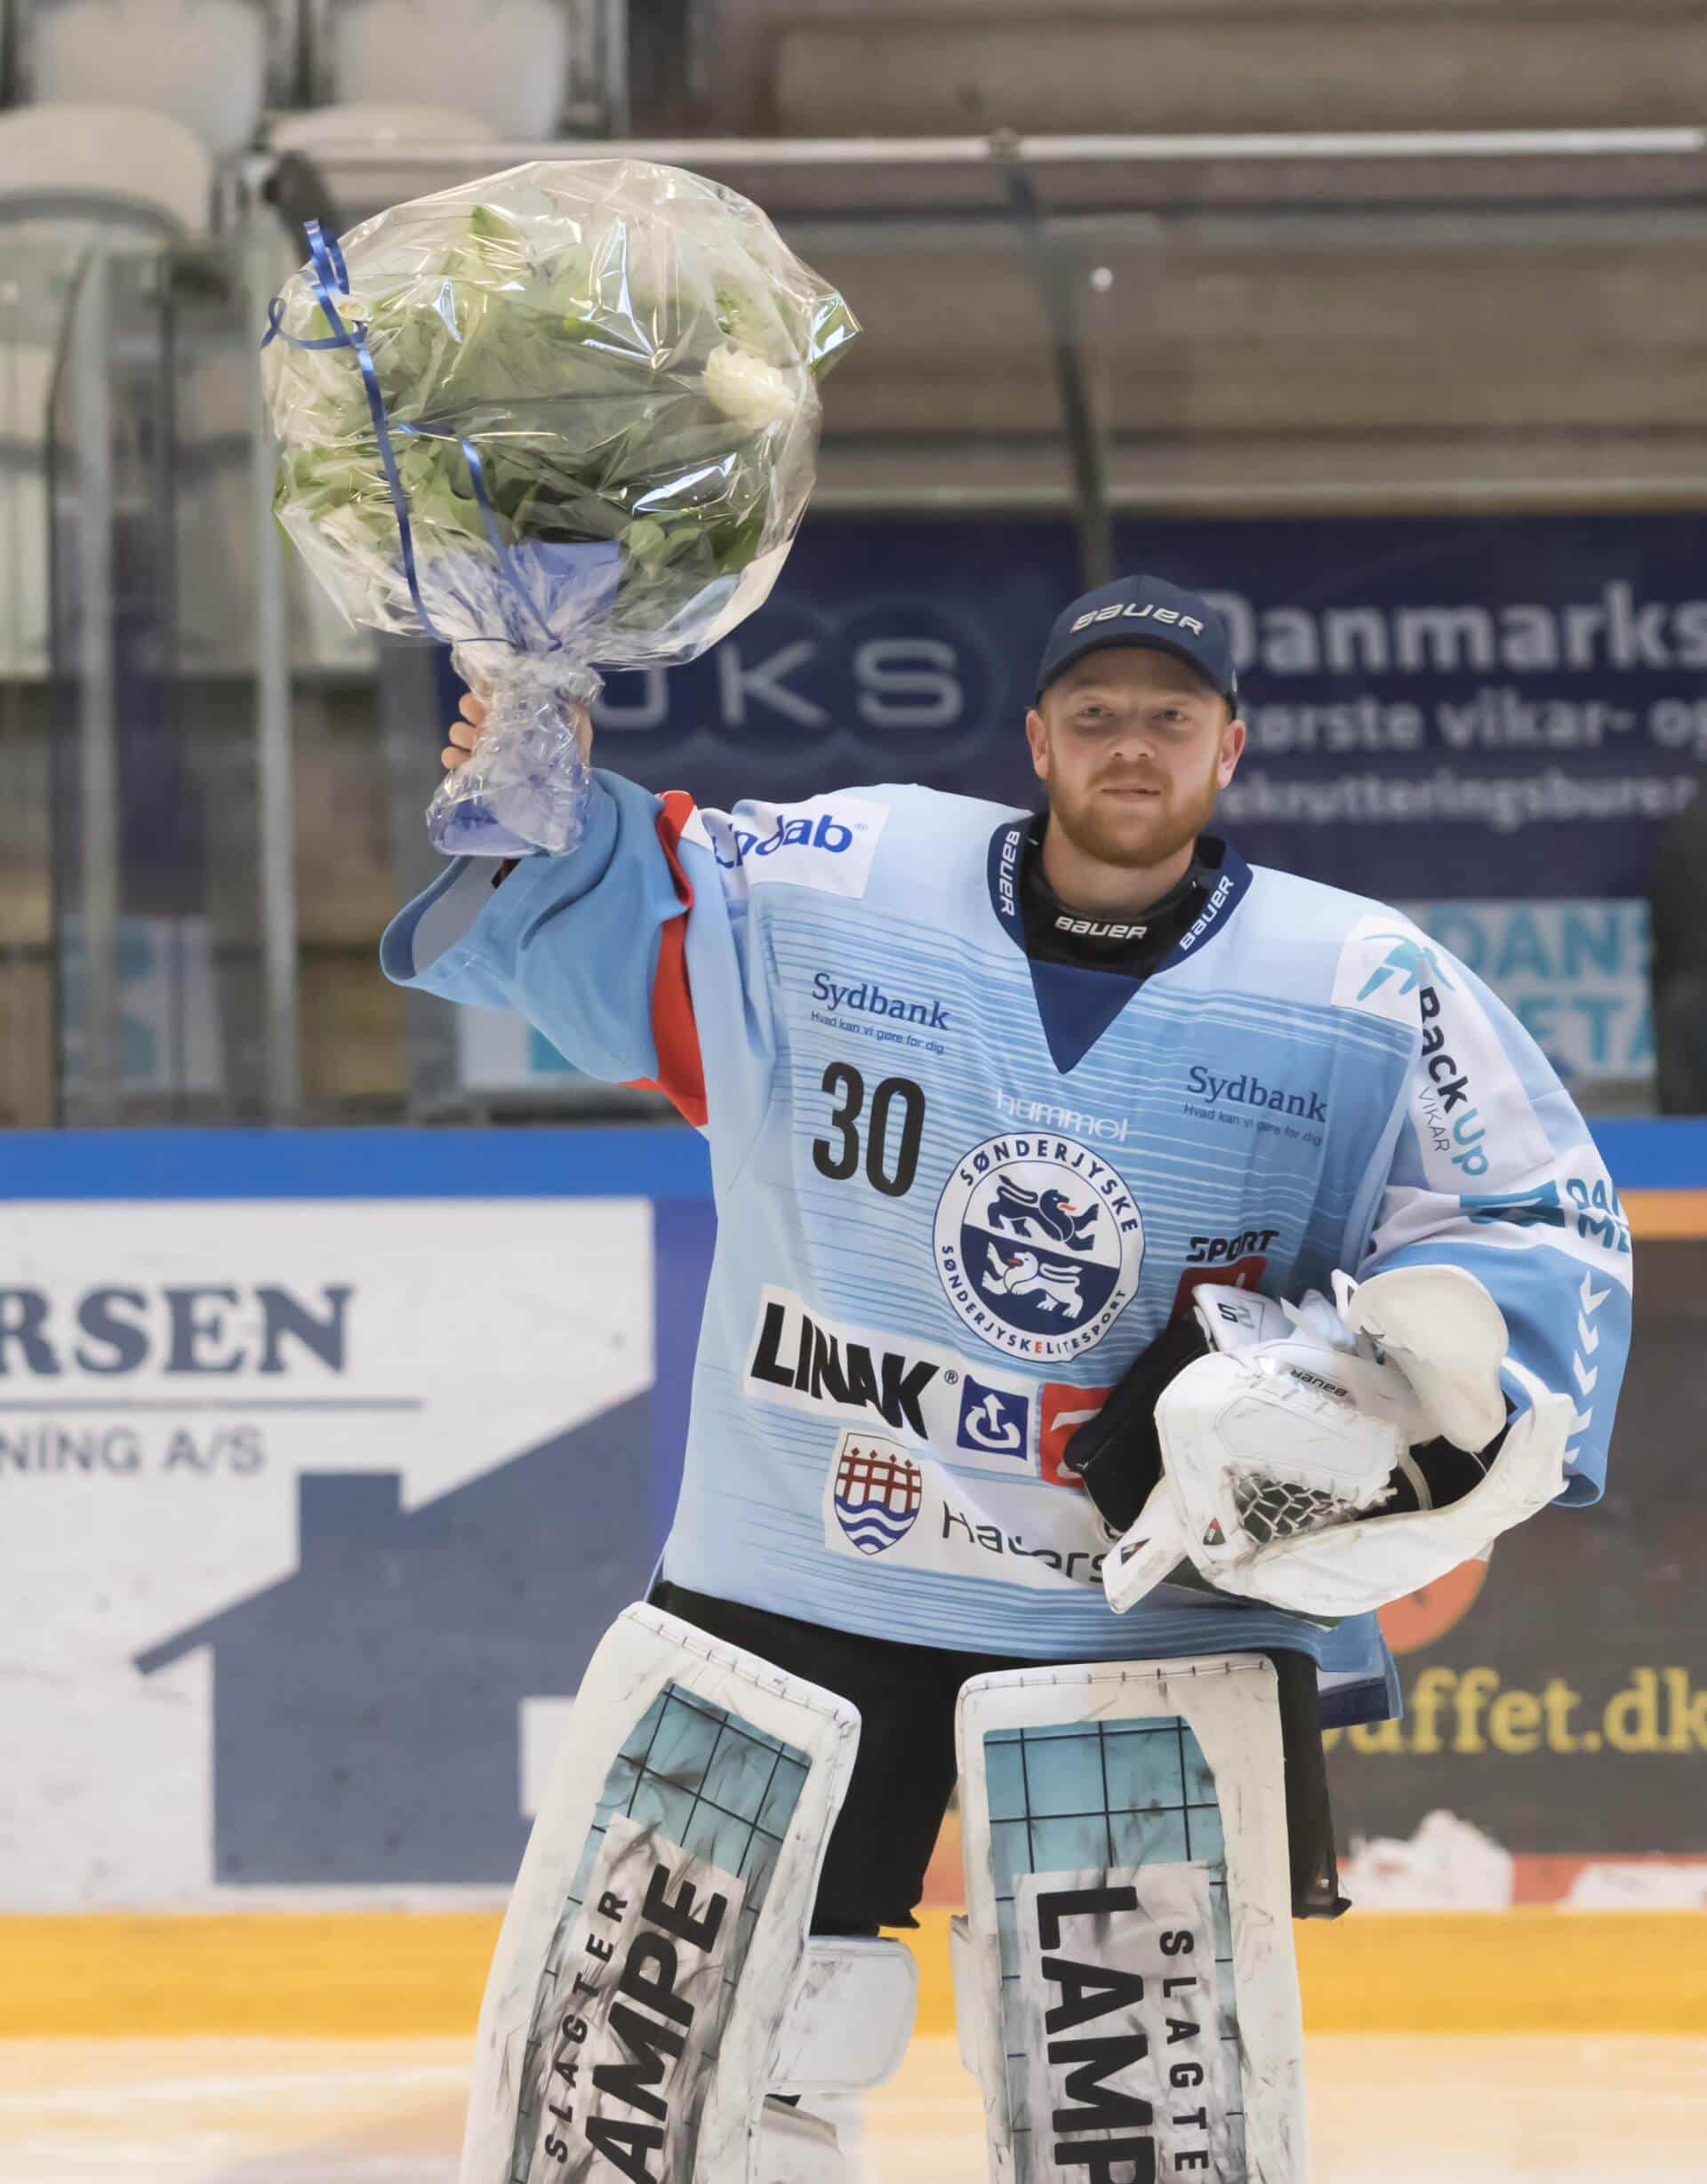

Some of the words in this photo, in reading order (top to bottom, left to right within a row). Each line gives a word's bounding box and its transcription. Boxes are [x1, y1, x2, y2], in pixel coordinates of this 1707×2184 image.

[1070, 604, 1204, 636] BAUER
[998, 830, 1021, 916] BAUER
[1054, 916, 1147, 940] BAUER
[1179, 875, 1234, 951] BAUER
[813, 972, 951, 1031] Sydbank
[811, 1011, 837, 1027] Hvad
[839, 1018, 860, 1034] kan
[864, 1025, 873, 1036] vi
[906, 1034, 925, 1048] for
[926, 1040, 944, 1055] dig
[996, 1087, 1129, 1142] hummel
[1187, 1065, 1327, 1123] Sydbank
[1418, 1086, 1450, 1153] VIKAR
[813, 1061, 926, 1197] 30
[1184, 1102, 1215, 1120] Hvad
[1219, 1112, 1239, 1125] kan
[1245, 1116, 1254, 1128] vi
[1285, 1126, 1301, 1139] for
[1302, 1132, 1322, 1147] dig
[959, 1140, 1139, 1233] SØNDERJYSKE
[1186, 1230, 1279, 1263] SPORT
[0, 1285, 355, 1376] RSEN
[1290, 1369, 1348, 1396] BAUER
[0, 1426, 143, 1475] NING
[164, 1426, 266, 1475] A/S
[1321, 1665, 1707, 1755] uffet.dk
[545, 1891, 628, 2164] SLAGTER
[1159, 1930, 1210, 2172] SLAGTE
